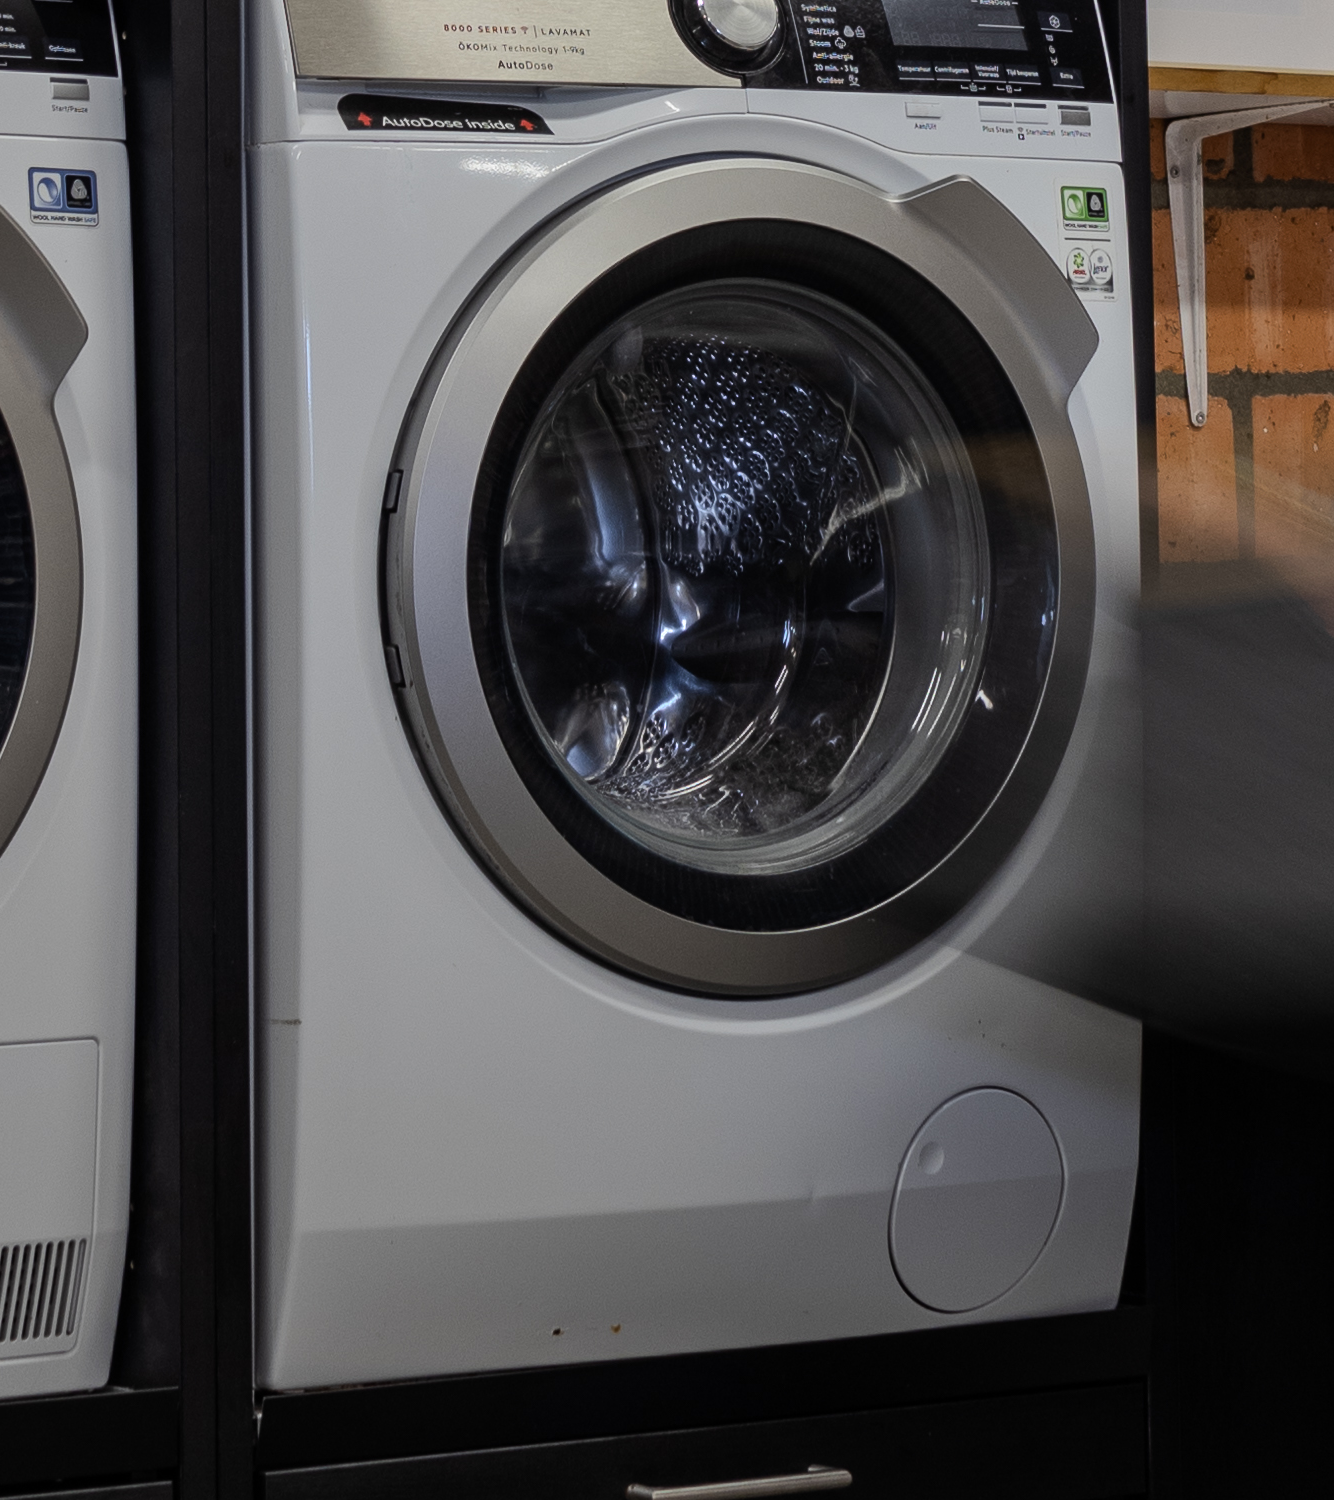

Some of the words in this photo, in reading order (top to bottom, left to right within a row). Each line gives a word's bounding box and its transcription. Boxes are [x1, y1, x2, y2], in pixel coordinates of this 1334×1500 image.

[801, 4, 837, 13] Synthetica
[443, 24, 473, 33] 8000
[478, 25, 517, 34] SERIES
[541, 28, 591, 36] LAVAMAT
[502, 44, 558, 55] Technology
[562, 46, 585, 55] 1-9kg
[498, 60, 554, 71] AutoDose
[849, 65, 859, 74] kg
[816, 76, 845, 84] Outdoor
[382, 116, 463, 129] AutoDose
[467, 119, 515, 131] inside
[914, 123, 937, 131] Aan/Uit
[982, 125, 995, 133] Plus
[995, 126, 1014, 134] Steam
